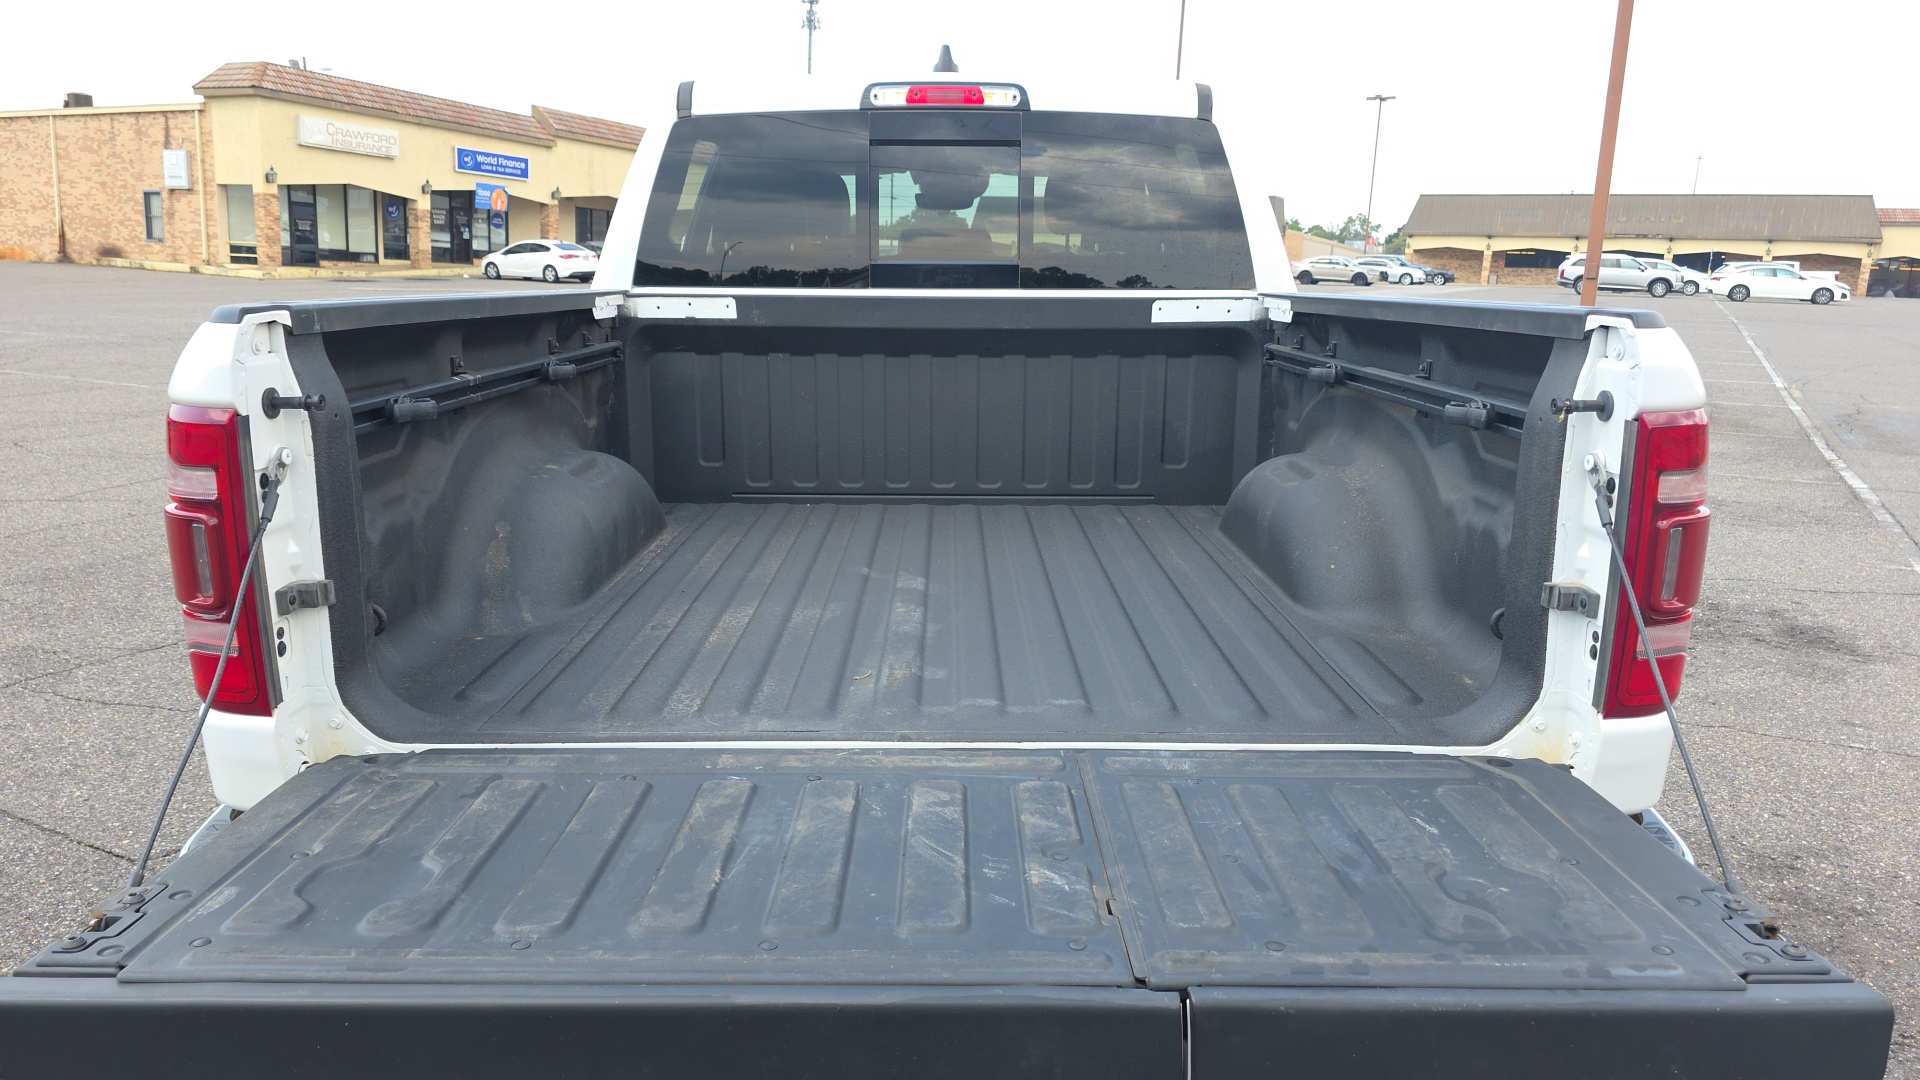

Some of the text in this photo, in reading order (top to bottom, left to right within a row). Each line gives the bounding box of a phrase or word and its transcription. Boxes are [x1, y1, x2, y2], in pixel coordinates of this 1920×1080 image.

[326, 122, 397, 145] CRAWFORD
[331, 136, 392, 154] INSURANCE
[476, 154, 525, 169] World Finance
